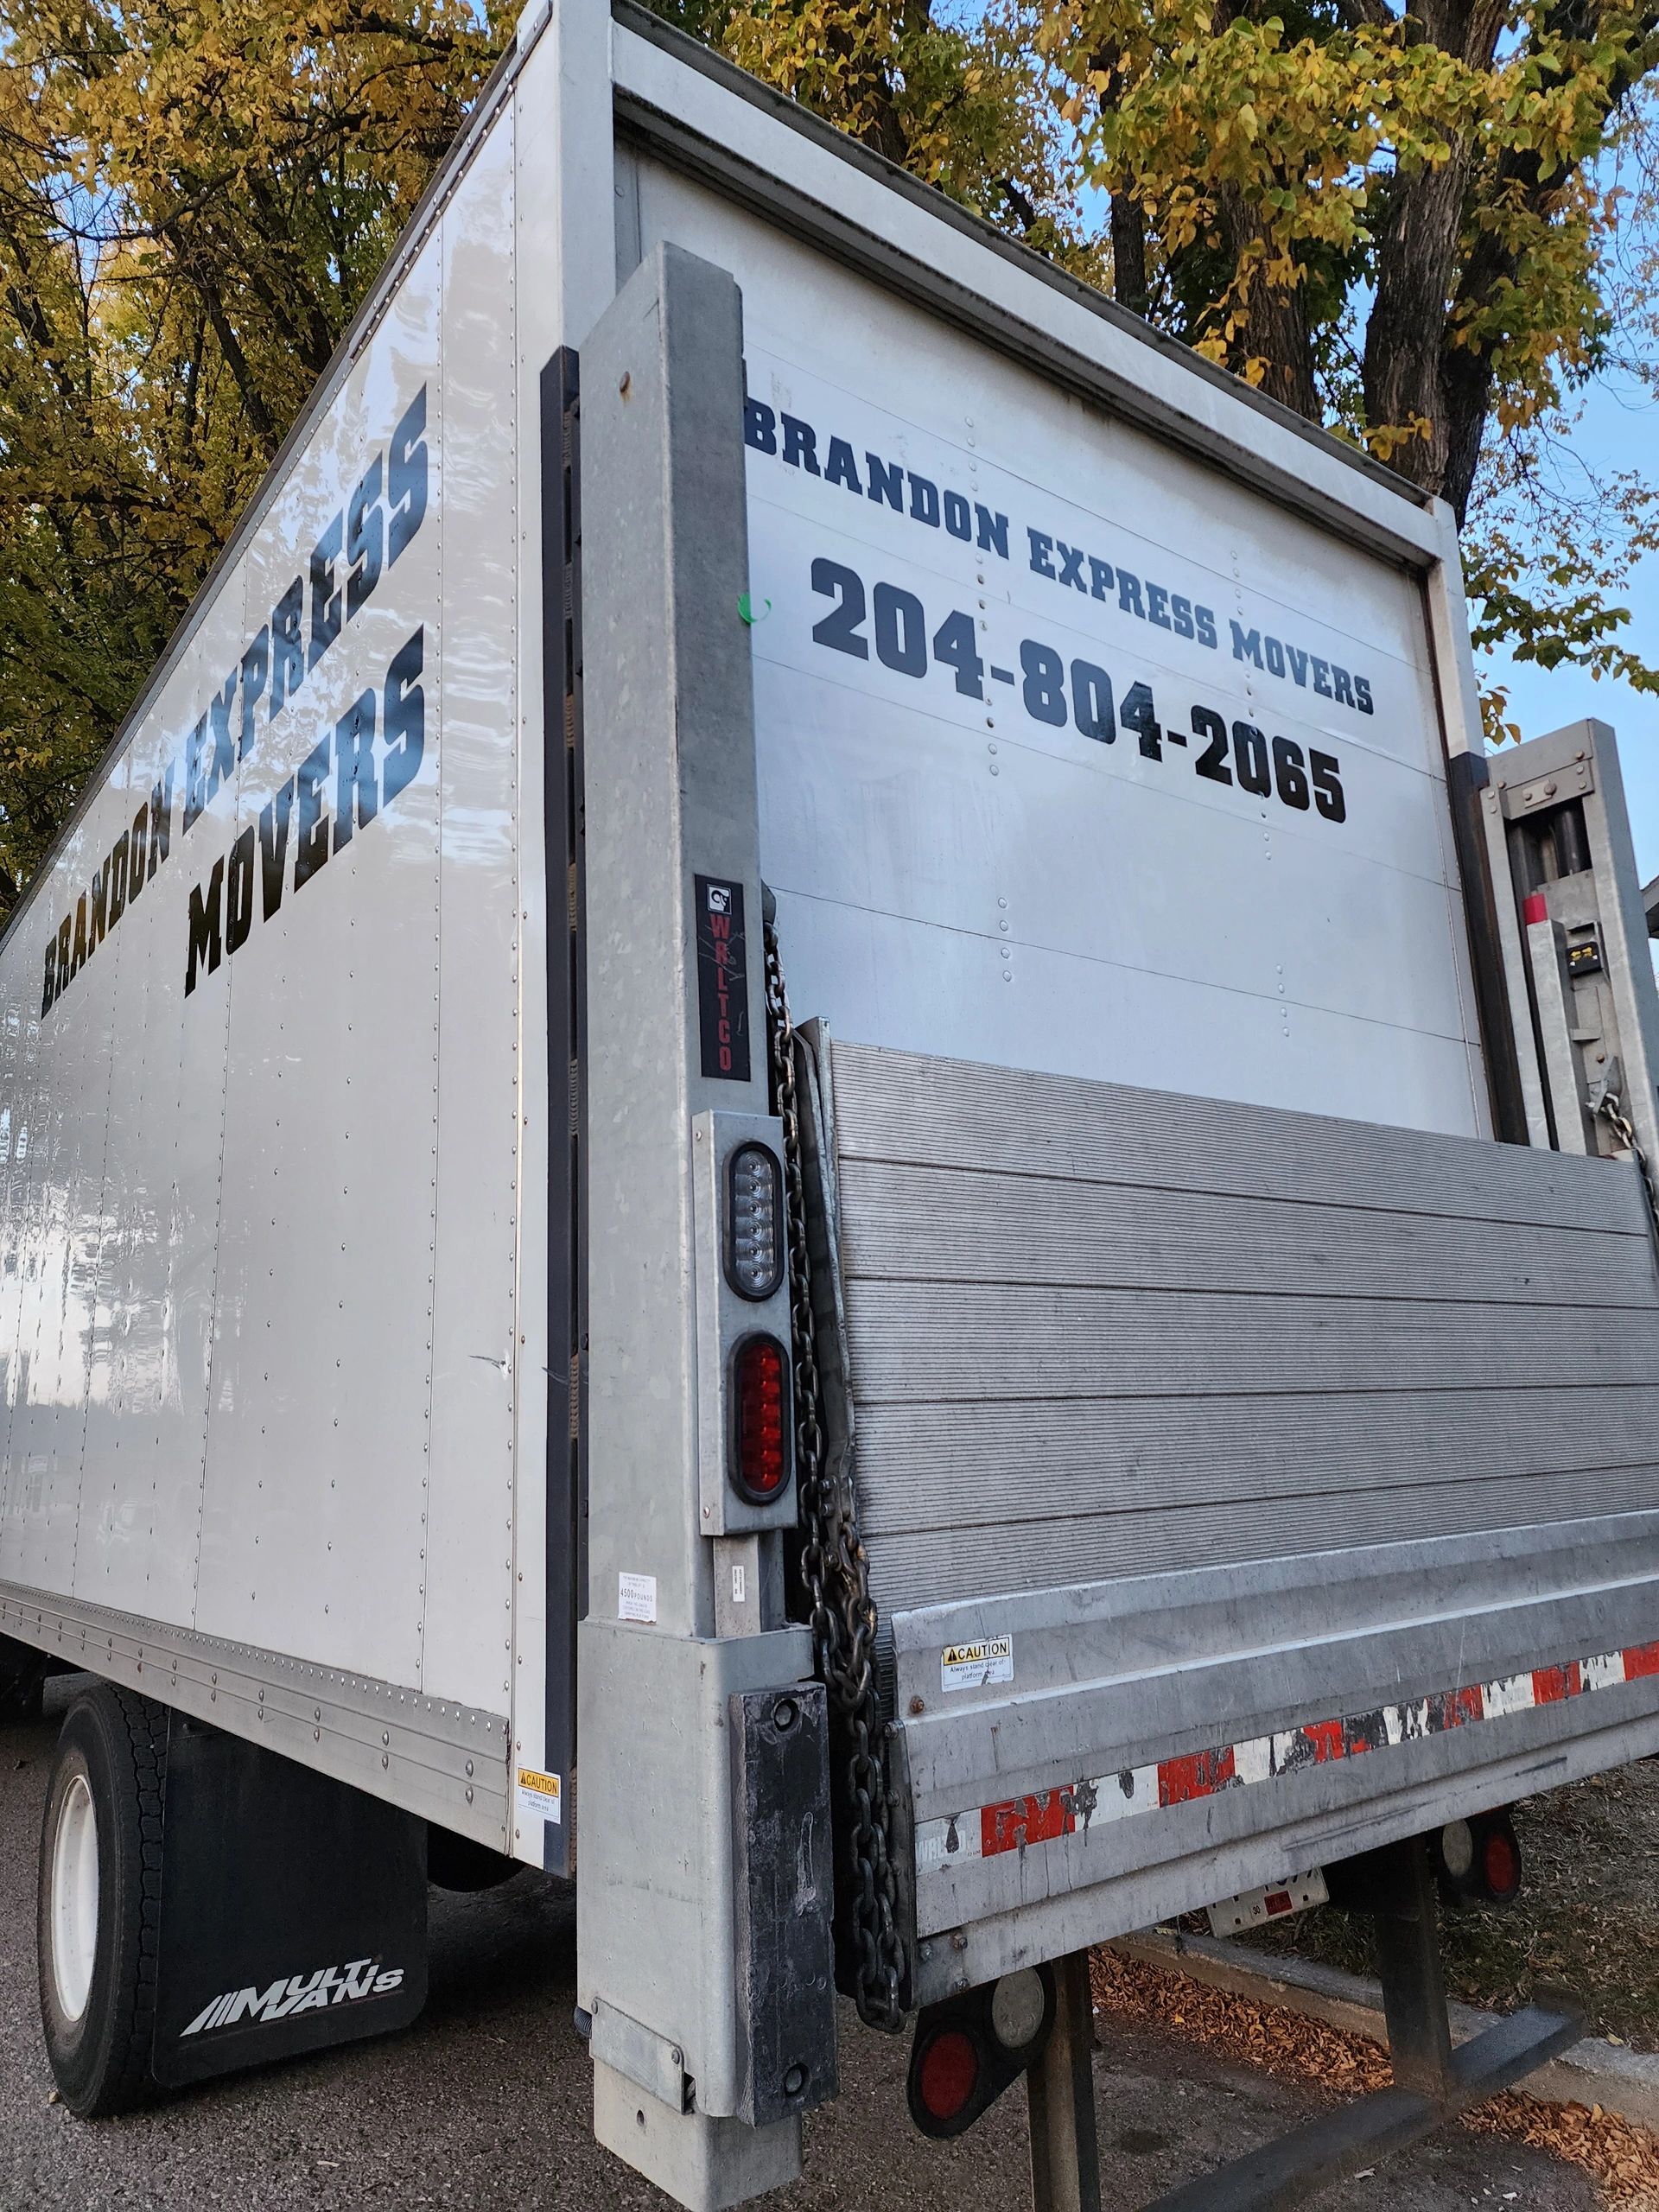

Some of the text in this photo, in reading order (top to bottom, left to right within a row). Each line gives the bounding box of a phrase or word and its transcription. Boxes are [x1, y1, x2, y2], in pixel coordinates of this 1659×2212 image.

[744, 396, 1374, 715] BRANDON EXPRESS MOVERS
[41, 380, 429, 1020] BRANDON EXPRESS
[810, 556, 1347, 823] 204-804-2065
[184, 622, 426, 999] MOVERS
[957, 1642, 1007, 1660] CAUTION
[950, 1664, 969, 1673] Always
[961, 1672, 982, 1681] platform
[526, 1774, 557, 1795] CAUTION
[1252, 1904, 1261, 1916] 30
